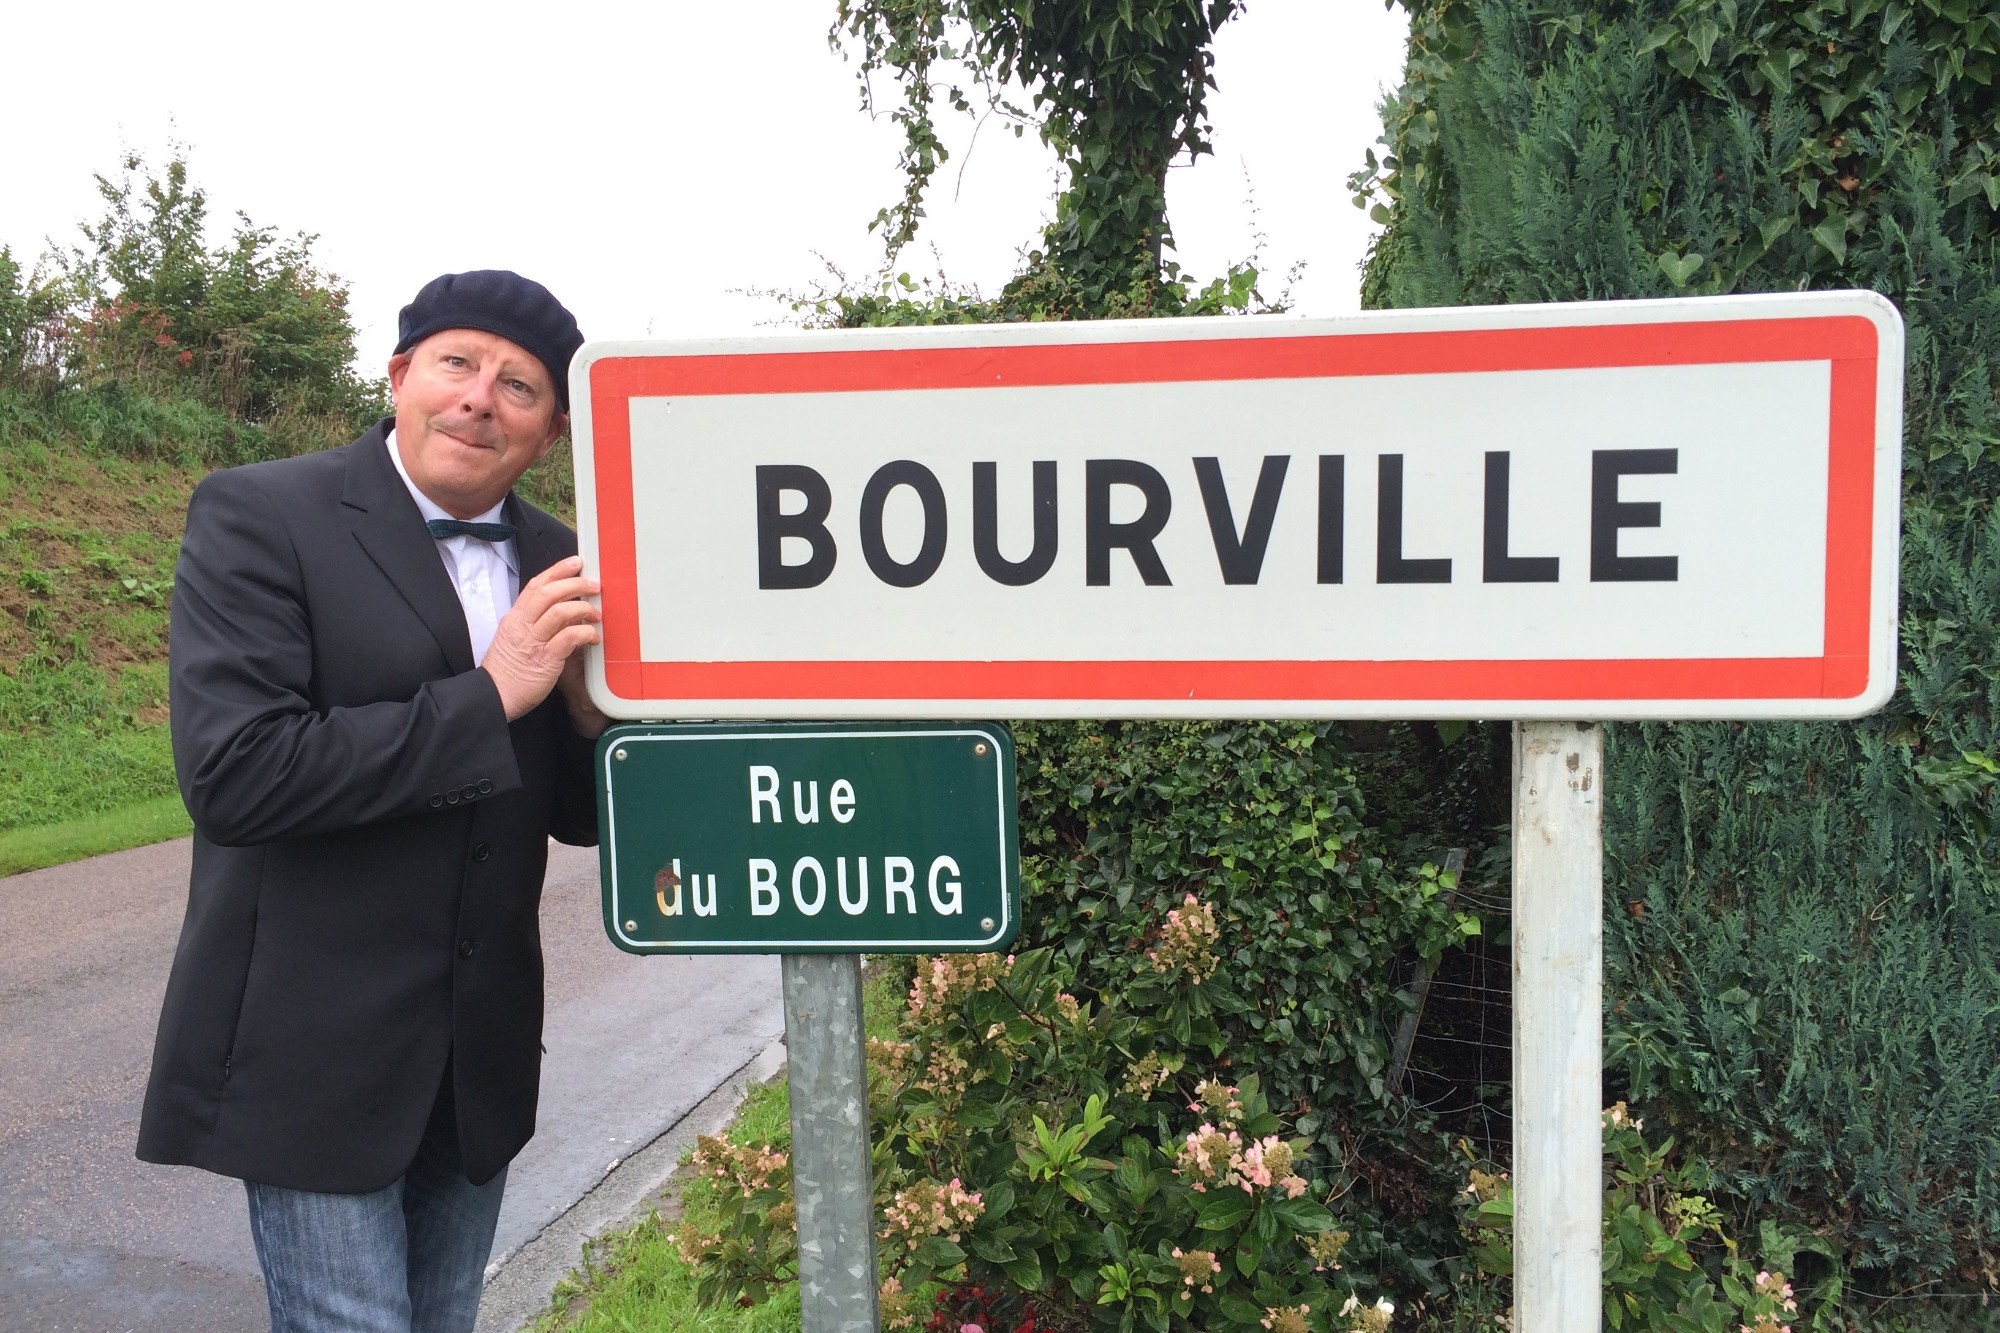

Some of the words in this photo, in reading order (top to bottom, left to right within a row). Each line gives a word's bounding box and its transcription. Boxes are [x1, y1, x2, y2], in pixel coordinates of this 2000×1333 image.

[756, 448, 1679, 590] BOURVILLE
[749, 765, 857, 824] Rue
[655, 858, 719, 917] du
[748, 854, 964, 916] BOURG
